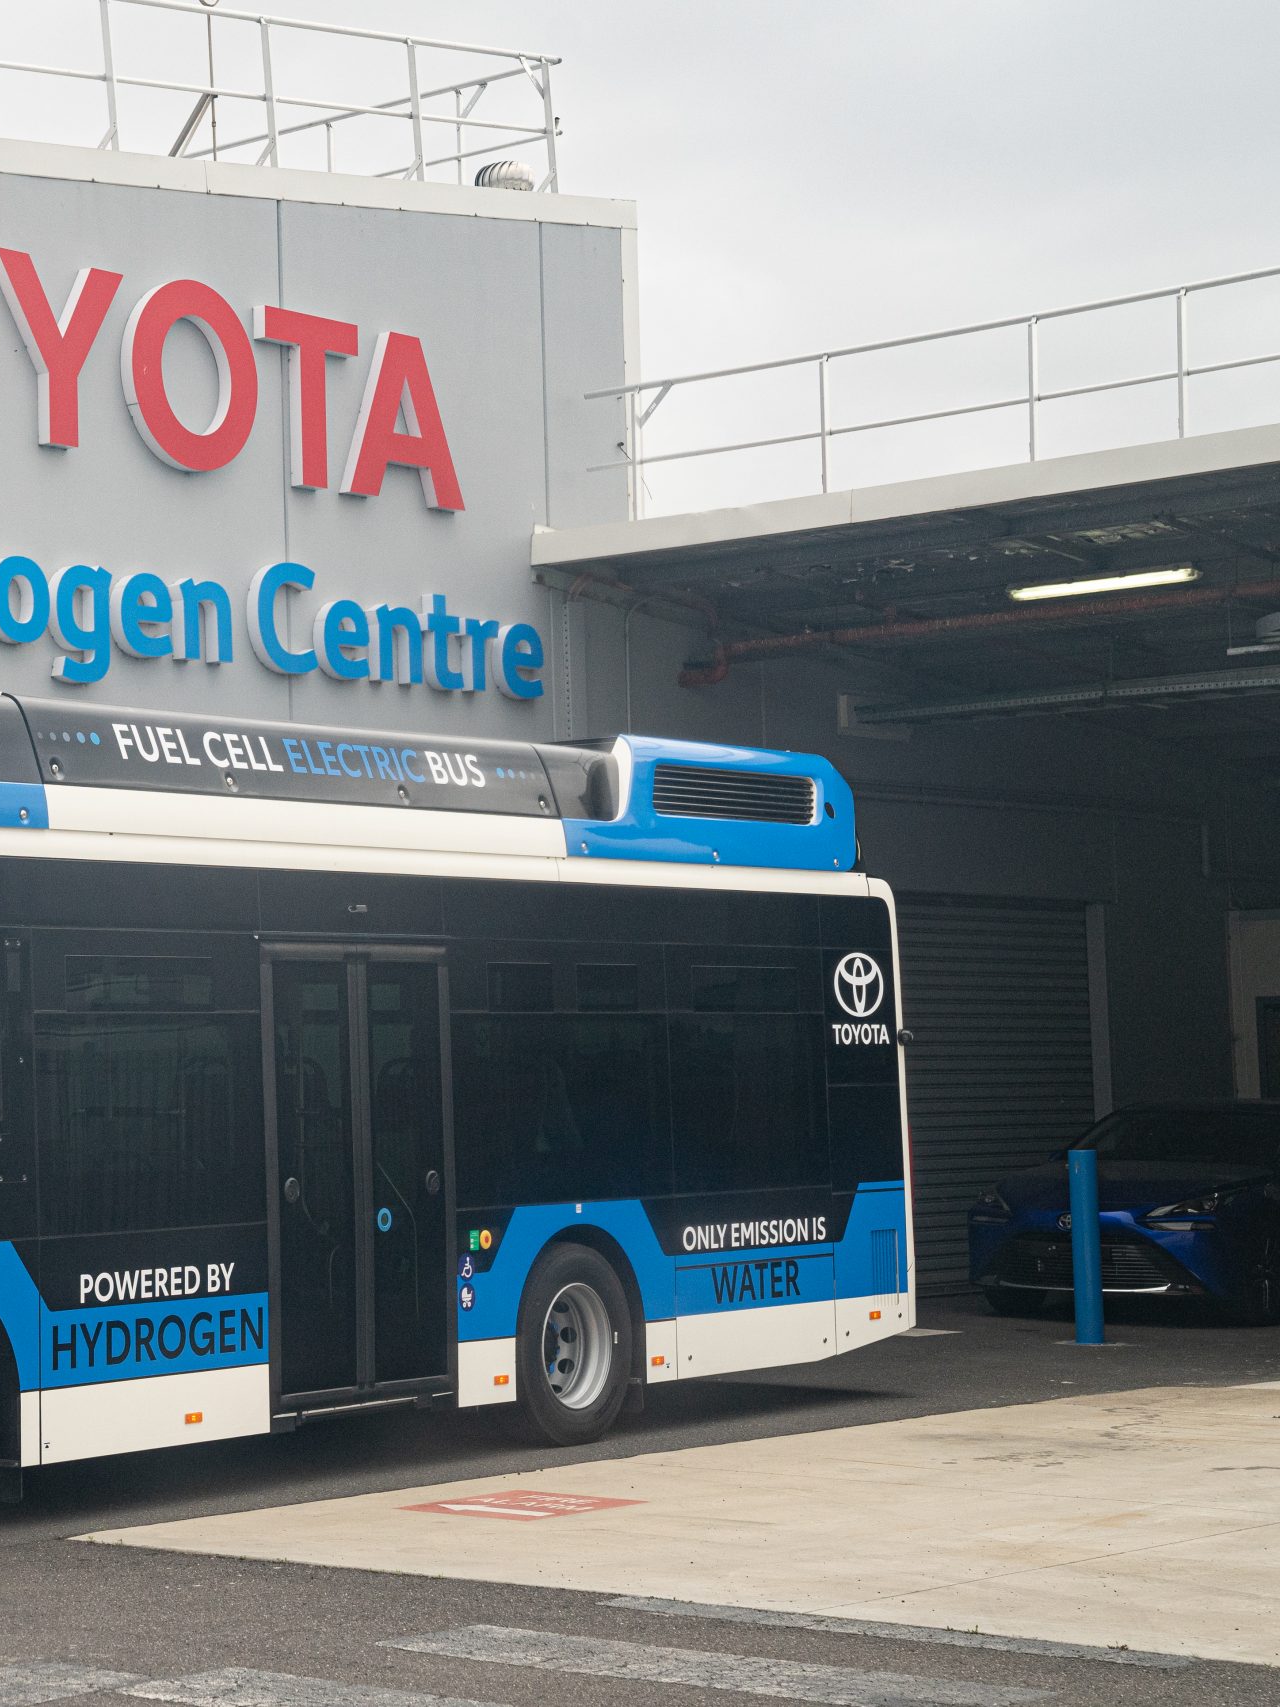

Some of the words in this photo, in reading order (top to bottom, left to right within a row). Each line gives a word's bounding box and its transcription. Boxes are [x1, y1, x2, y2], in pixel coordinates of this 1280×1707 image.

[247, 562, 545, 700] Centre
[112, 723, 201, 766] FUEL
[202, 731, 284, 772] CELL
[281, 738, 425, 783] ELECTRIC
[424, 750, 487, 788] BUS
[832, 1023, 890, 1045] TOYOTA
[682, 1223, 727, 1251] ONLY
[731, 1217, 808, 1248] EMISSION
[812, 1216, 826, 1241] IS
[80, 1265, 201, 1304] POWERED
[207, 1262, 235, 1293] BY
[711, 1260, 801, 1304] WATER
[52, 1306, 263, 1371] HYDROGEN
[519, 1494, 601, 1504] FIRE
